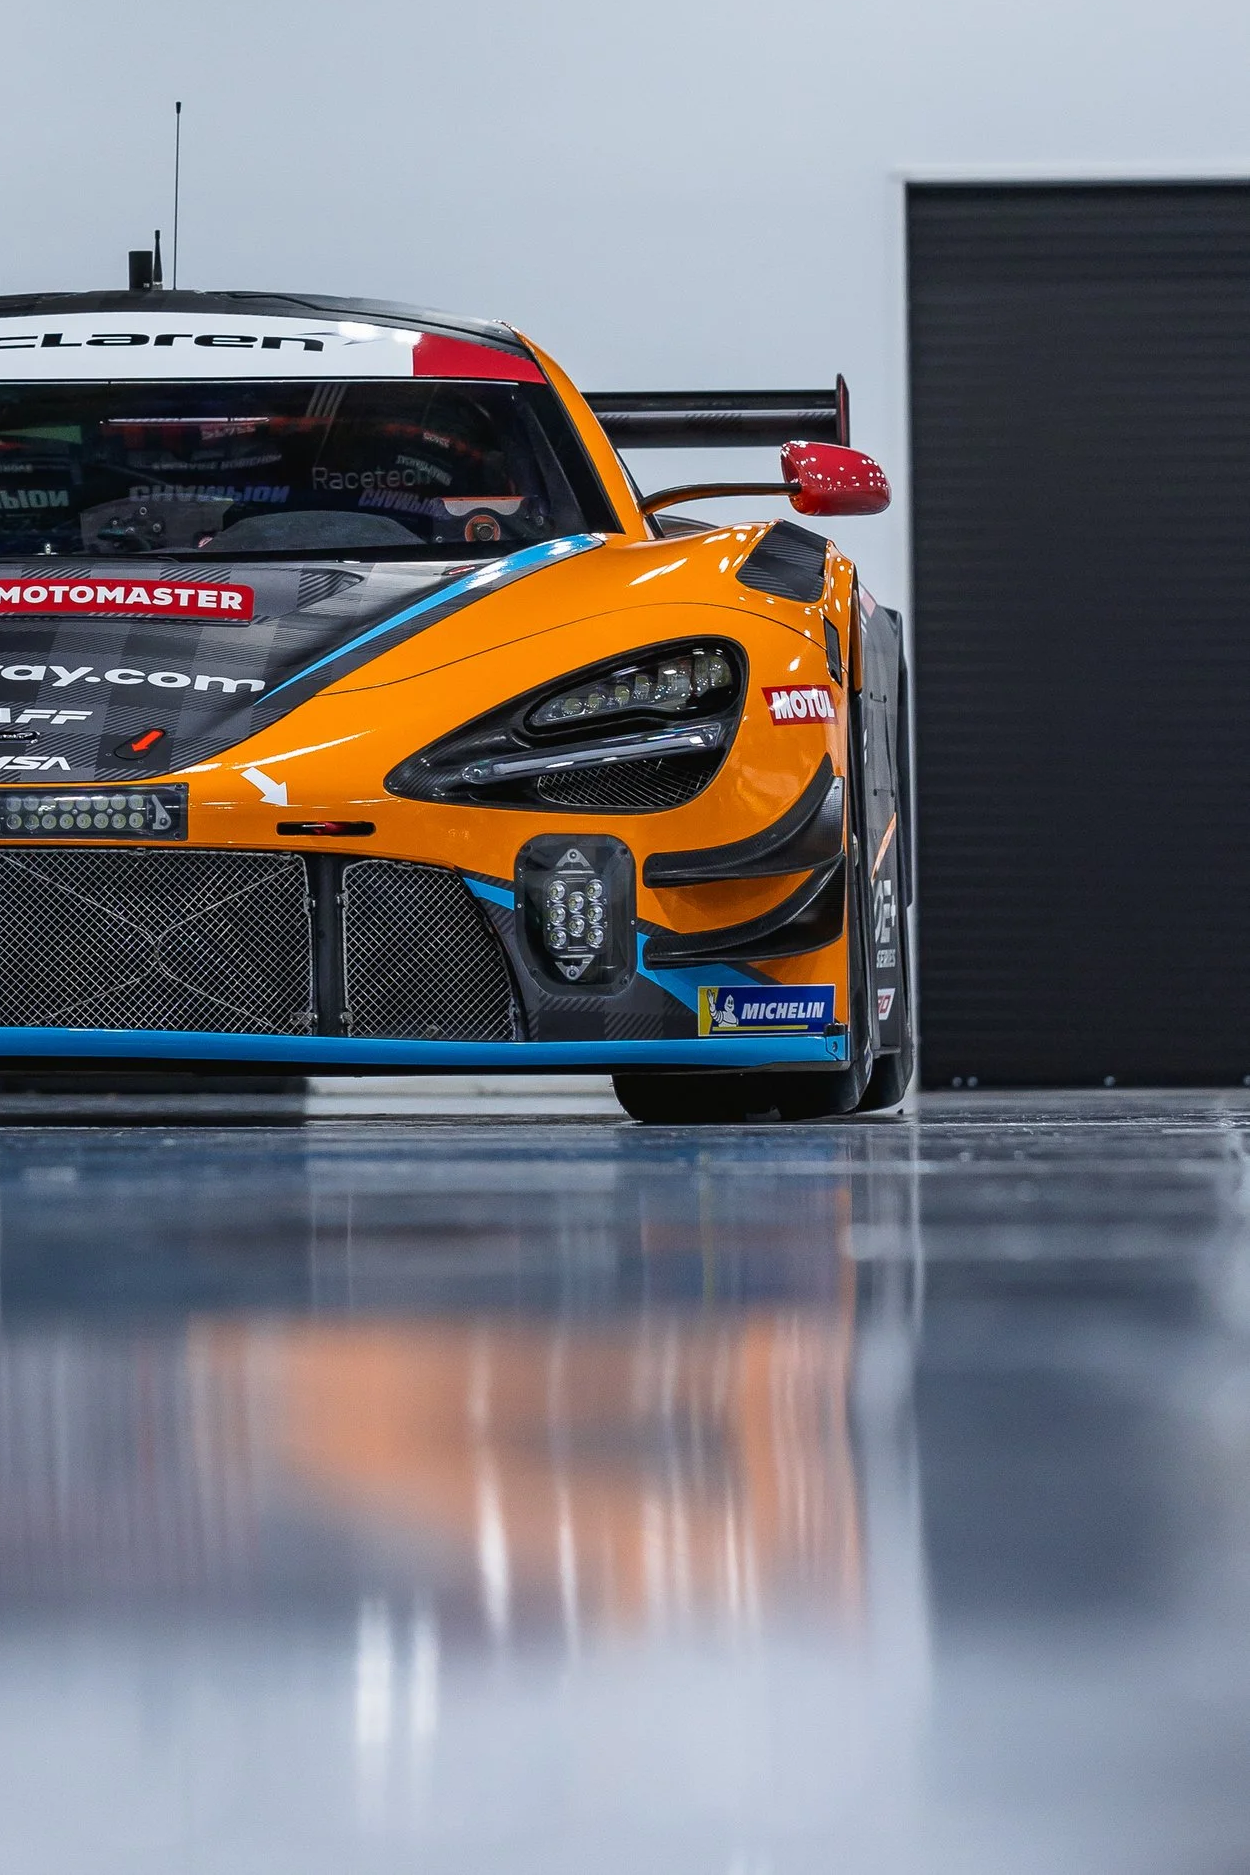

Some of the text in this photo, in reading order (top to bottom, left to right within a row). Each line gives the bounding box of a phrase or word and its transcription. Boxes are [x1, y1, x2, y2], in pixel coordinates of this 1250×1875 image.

[771, 689, 835, 719] MOTUL
[876, 949, 896, 968] SERIES
[740, 1002, 825, 1020] MICHELIN
